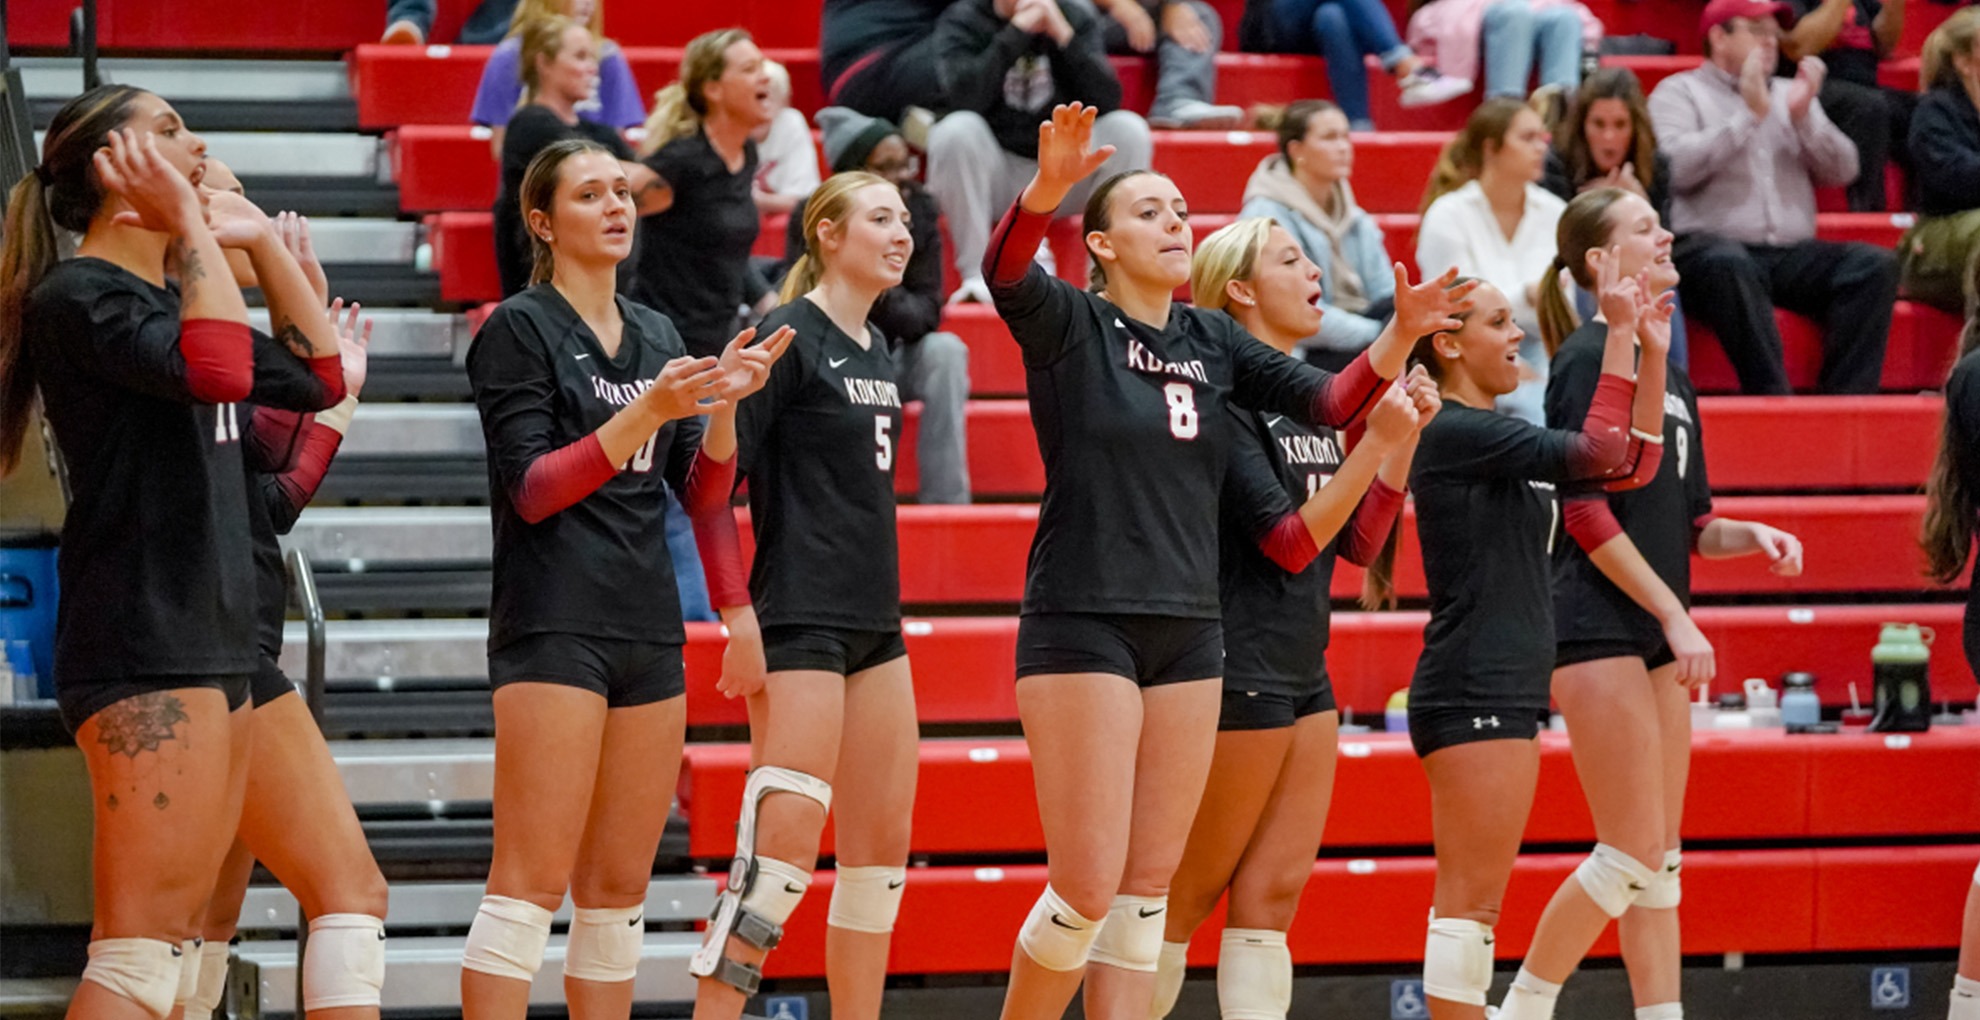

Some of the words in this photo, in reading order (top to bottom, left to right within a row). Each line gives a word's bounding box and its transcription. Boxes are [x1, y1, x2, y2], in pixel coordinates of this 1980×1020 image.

[843, 377, 902, 410] KOKOM
[1163, 381, 1199, 440] 8
[620, 428, 659, 473] 0
[874, 414, 892, 471] 5
[1278, 434, 1339, 465] KOKOM
[1675, 424, 1689, 479] 9
[1306, 472, 1335, 501] 1
